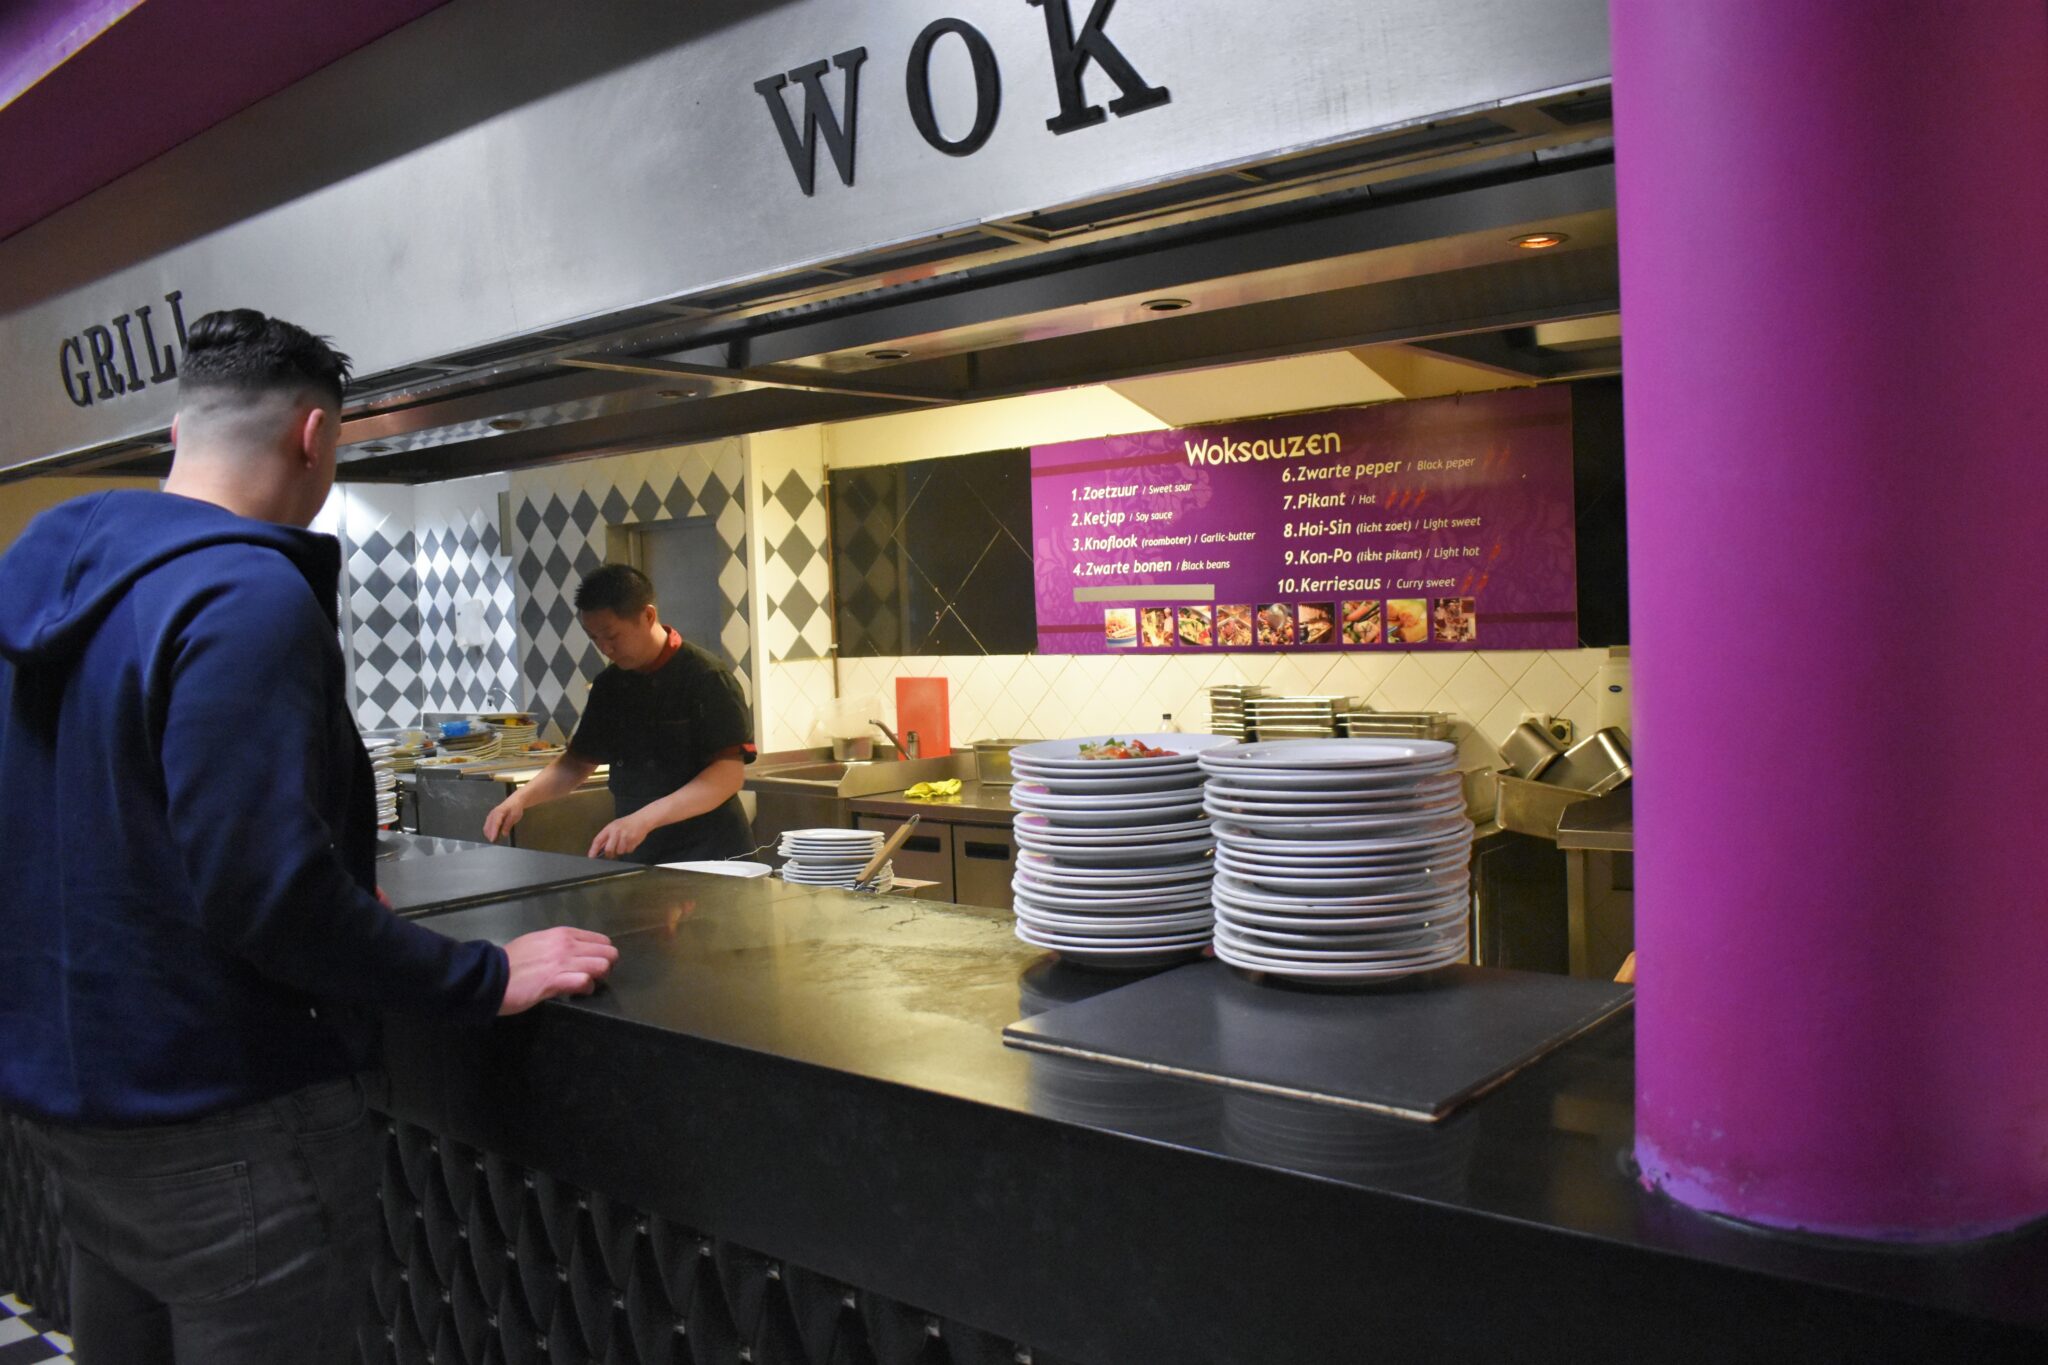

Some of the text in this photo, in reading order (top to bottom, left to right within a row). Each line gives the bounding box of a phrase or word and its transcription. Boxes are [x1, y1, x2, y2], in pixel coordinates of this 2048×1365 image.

[754, 0, 1171, 197] WOK
[1184, 432, 1341, 467] Woksauzen
[1355, 461, 1402, 480] peper
[1417, 460, 1443, 471] Black
[1446, 458, 1475, 469] peper
[1149, 484, 1172, 495] Sweet
[1174, 483, 1192, 492] sour
[1358, 494, 1376, 505] Hot
[1135, 512, 1149, 523] Soy
[1151, 511, 1173, 520] sauce
[1385, 520, 1412, 532] zoet)
[1423, 519, 1448, 531] Light
[1451, 517, 1481, 527] sweet
[1141, 534, 1191, 548] (roomboter)
[1200, 532, 1256, 543] Garlic-butter
[1385, 549, 1422, 563] pikant)
[1434, 548, 1459, 559] Light
[1462, 546, 1480, 557] hot
[1133, 560, 1172, 573] bonen
[1206, 560, 1230, 570] beans
[1396, 579, 1423, 590] Curry
[1426, 578, 1456, 588] sweet
